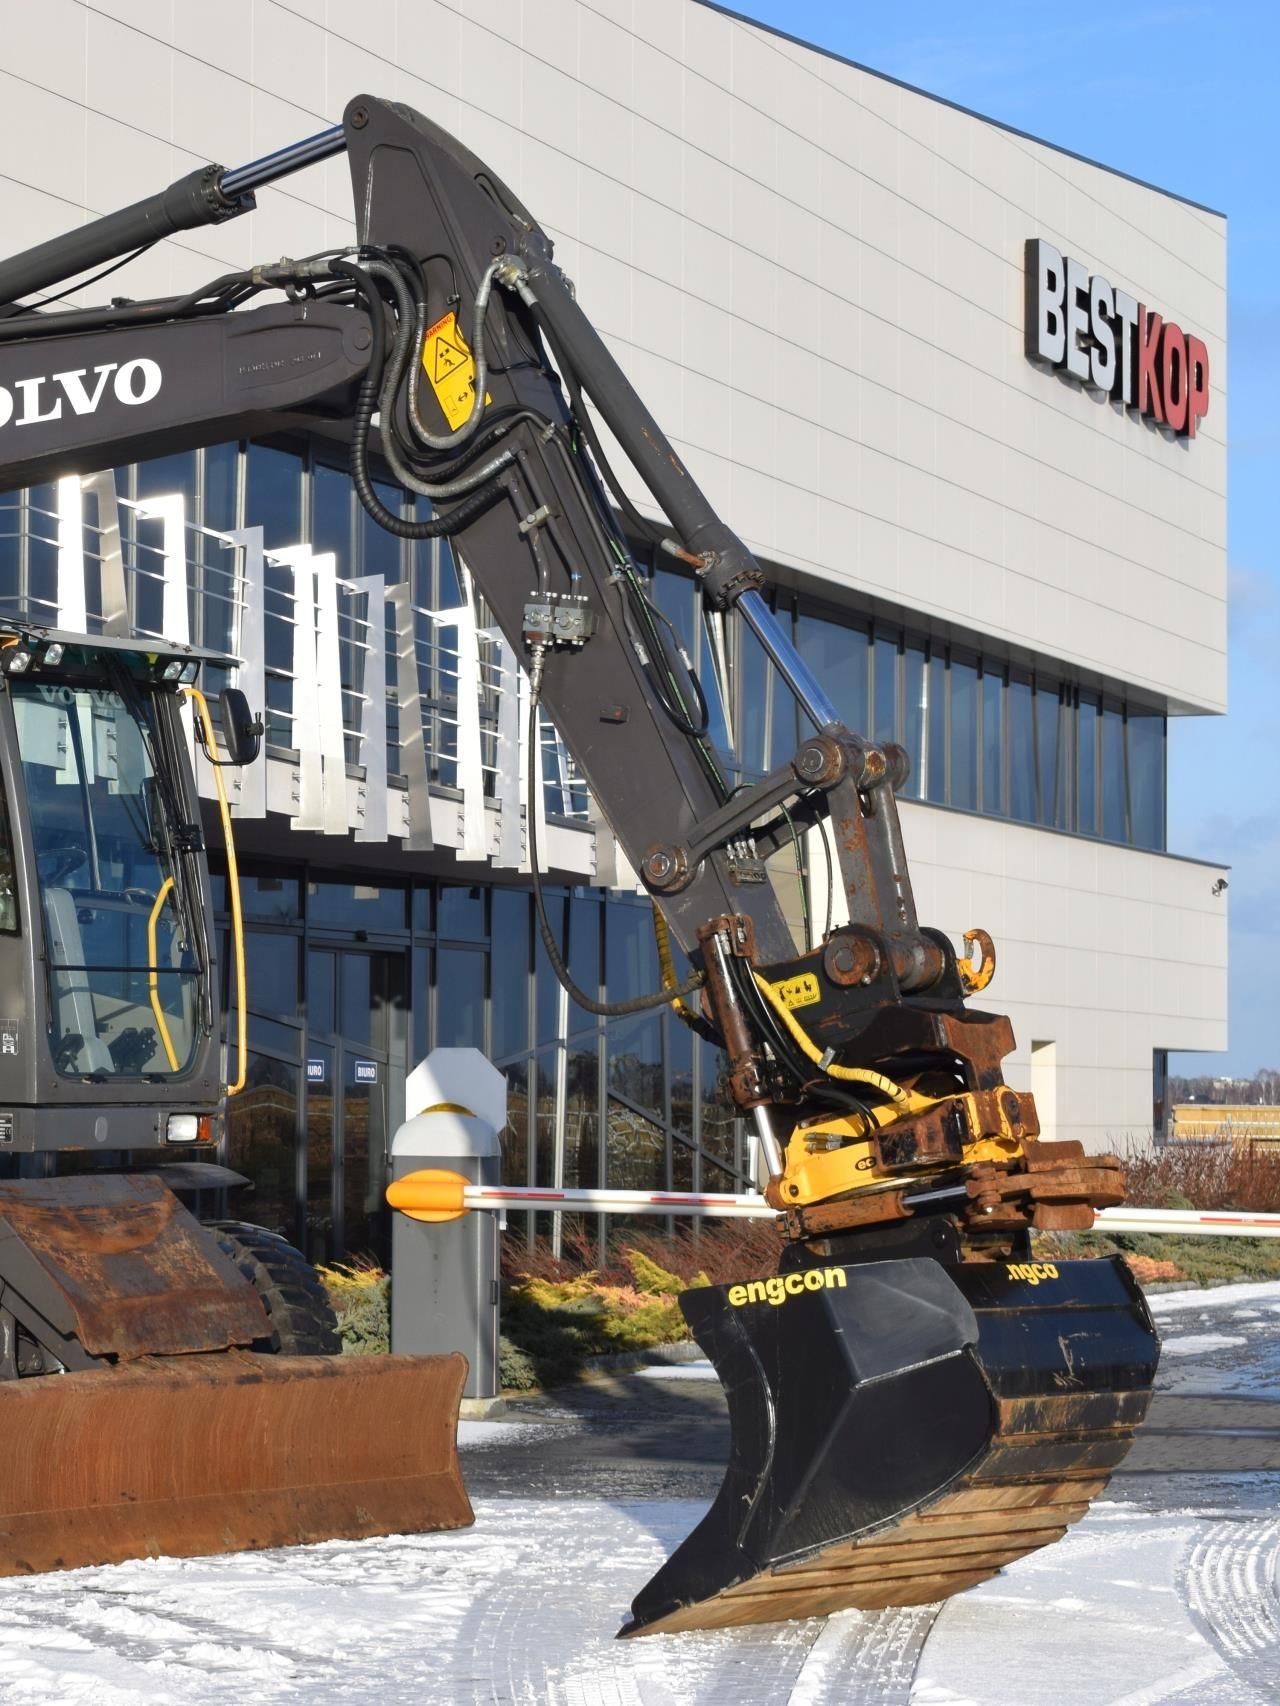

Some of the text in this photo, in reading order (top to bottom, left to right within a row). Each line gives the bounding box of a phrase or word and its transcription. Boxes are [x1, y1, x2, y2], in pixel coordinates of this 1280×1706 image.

[1028, 238, 1209, 440] BESTKOP
[357, 1067, 376, 1078] BIURO
[728, 1267, 847, 1306] engcon
[1004, 1263, 1059, 1286] ngco
